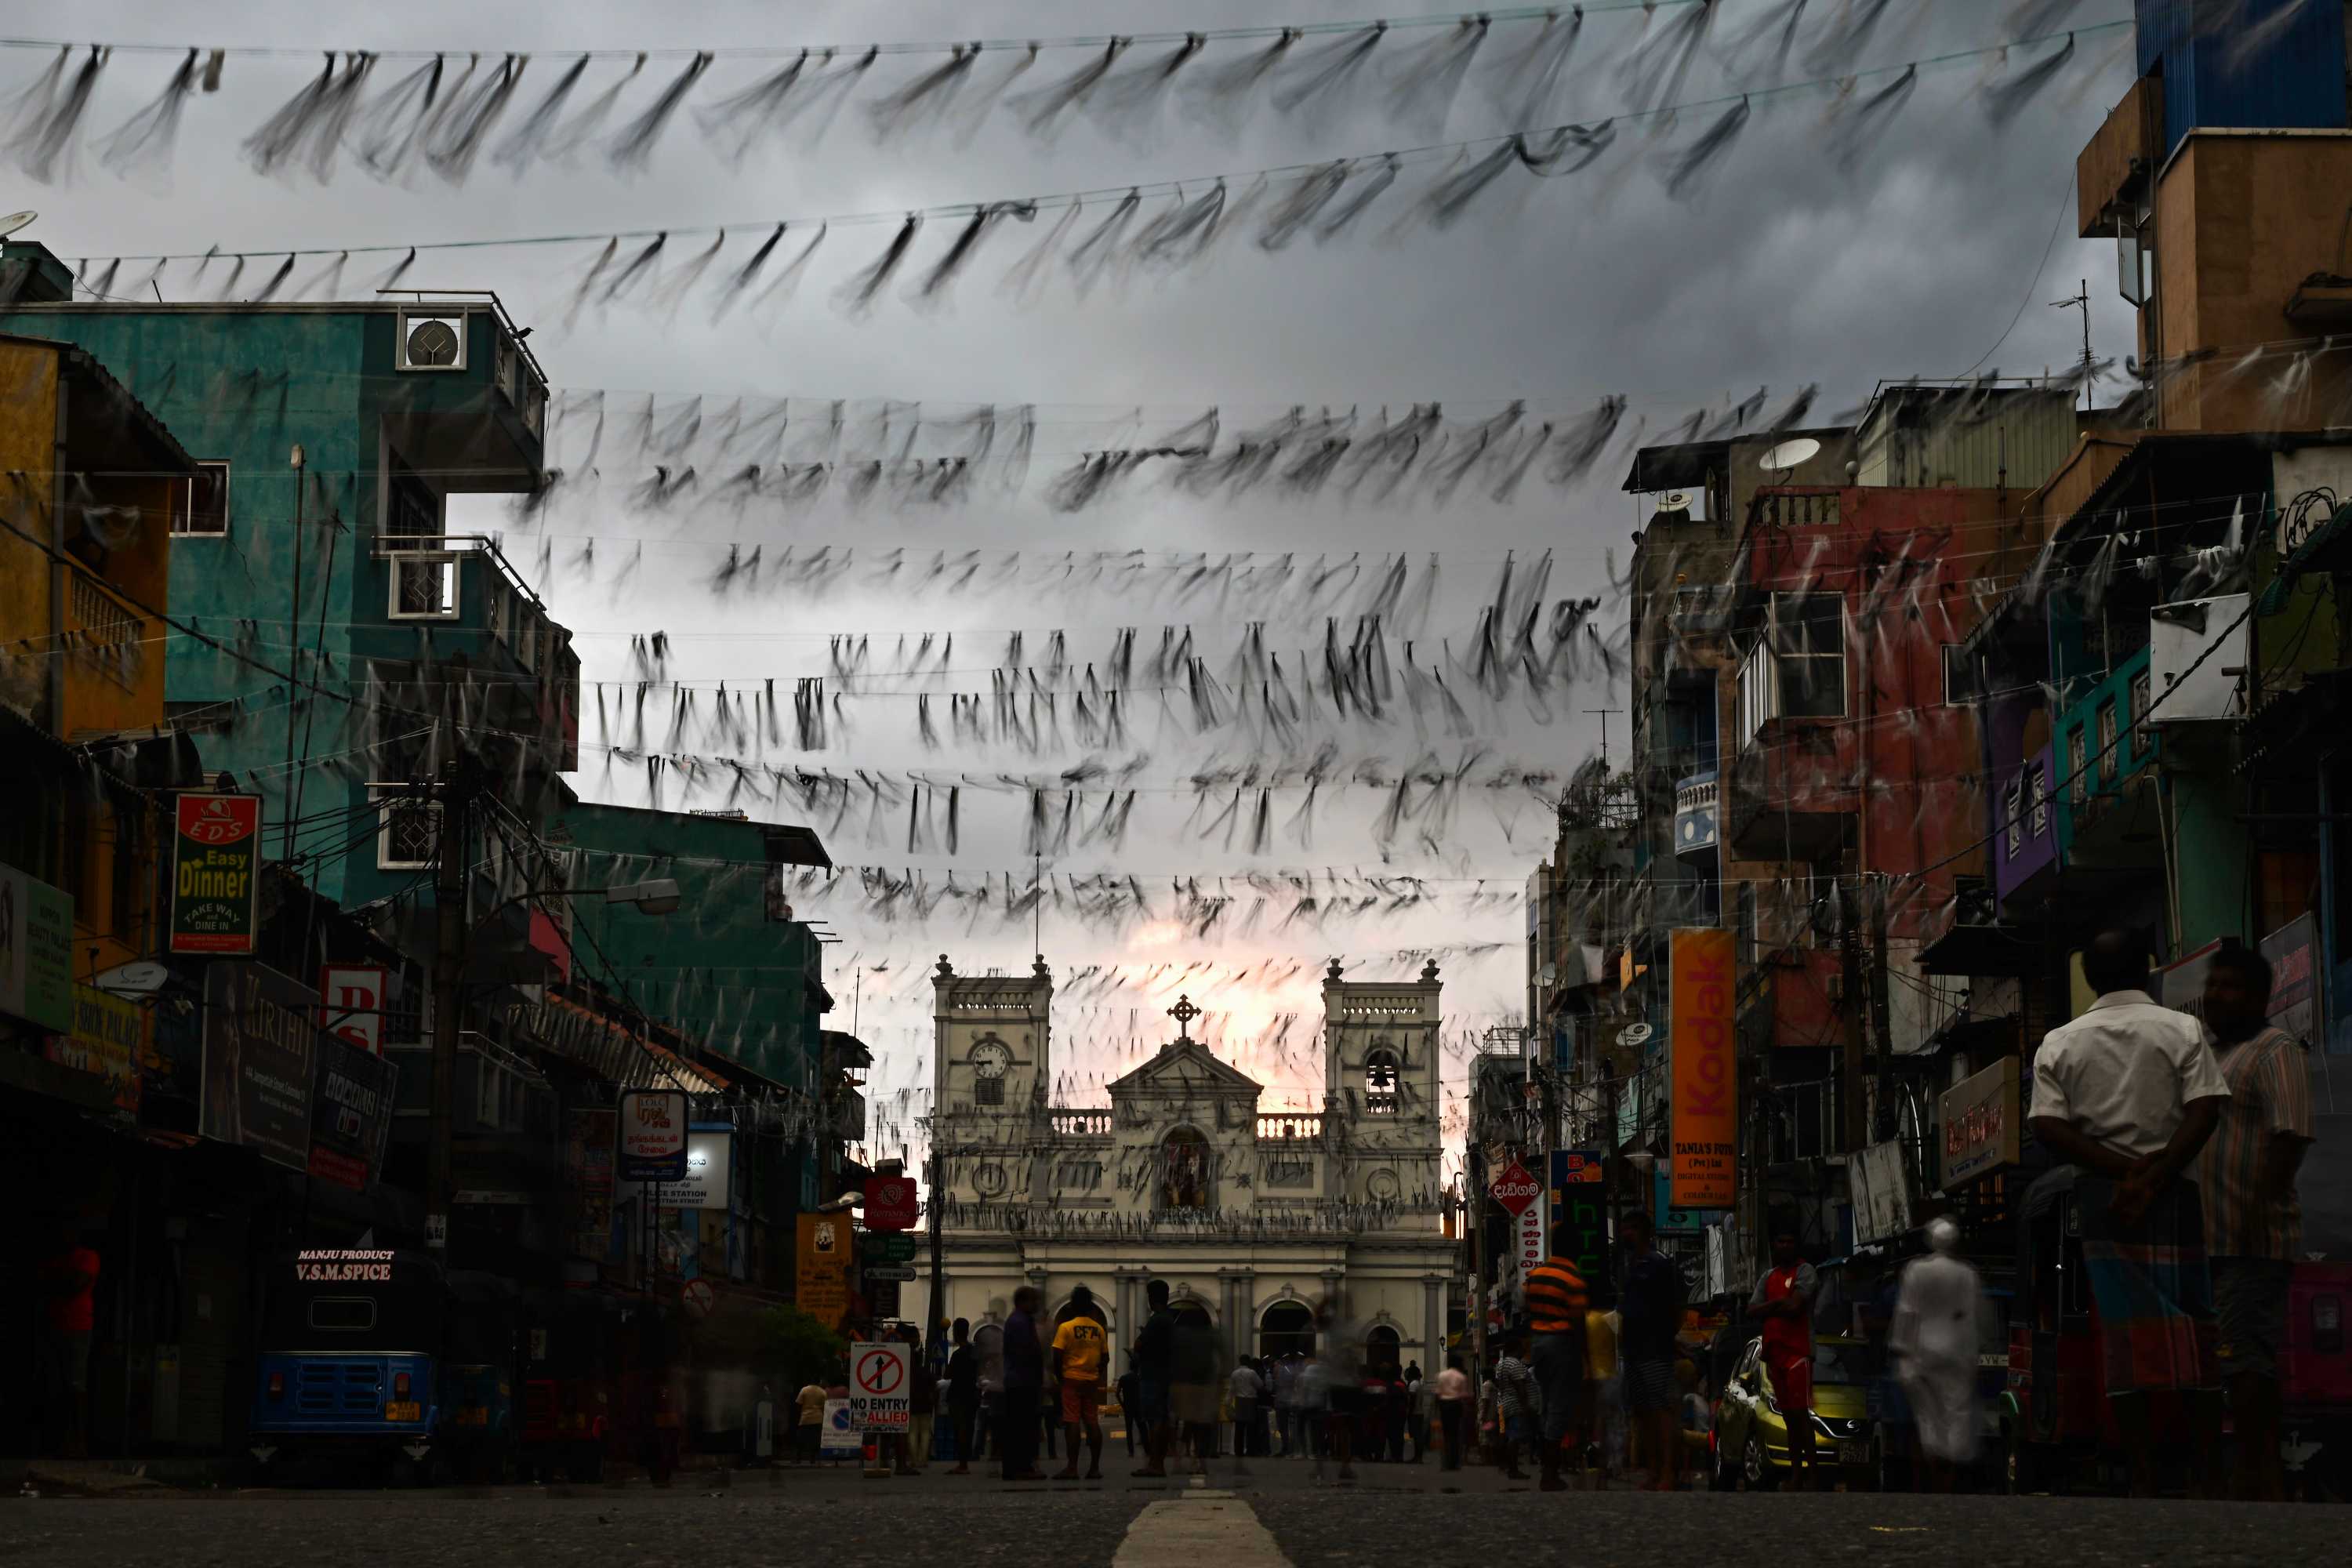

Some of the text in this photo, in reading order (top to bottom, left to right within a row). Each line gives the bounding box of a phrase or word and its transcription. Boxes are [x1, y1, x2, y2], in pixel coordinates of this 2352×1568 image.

[189, 822, 244, 841] EDS
[207, 849, 249, 870] Easy
[179, 859, 250, 898] Dinner
[183, 903, 241, 924] TAKE WAY
[195, 921, 230, 931] DINE IN
[1686, 953, 1730, 1117] Kodak
[1675, 1142, 1711, 1155] TANIA'S
[298, 1250, 394, 1260] MANJU PRODUCT
[296, 1263, 391, 1280] V.S.M.SPICE
[851, 1398, 868, 1410] NO
[870, 1398, 909, 1410] ENTRY
[867, 1411, 909, 1425] ALLIED
